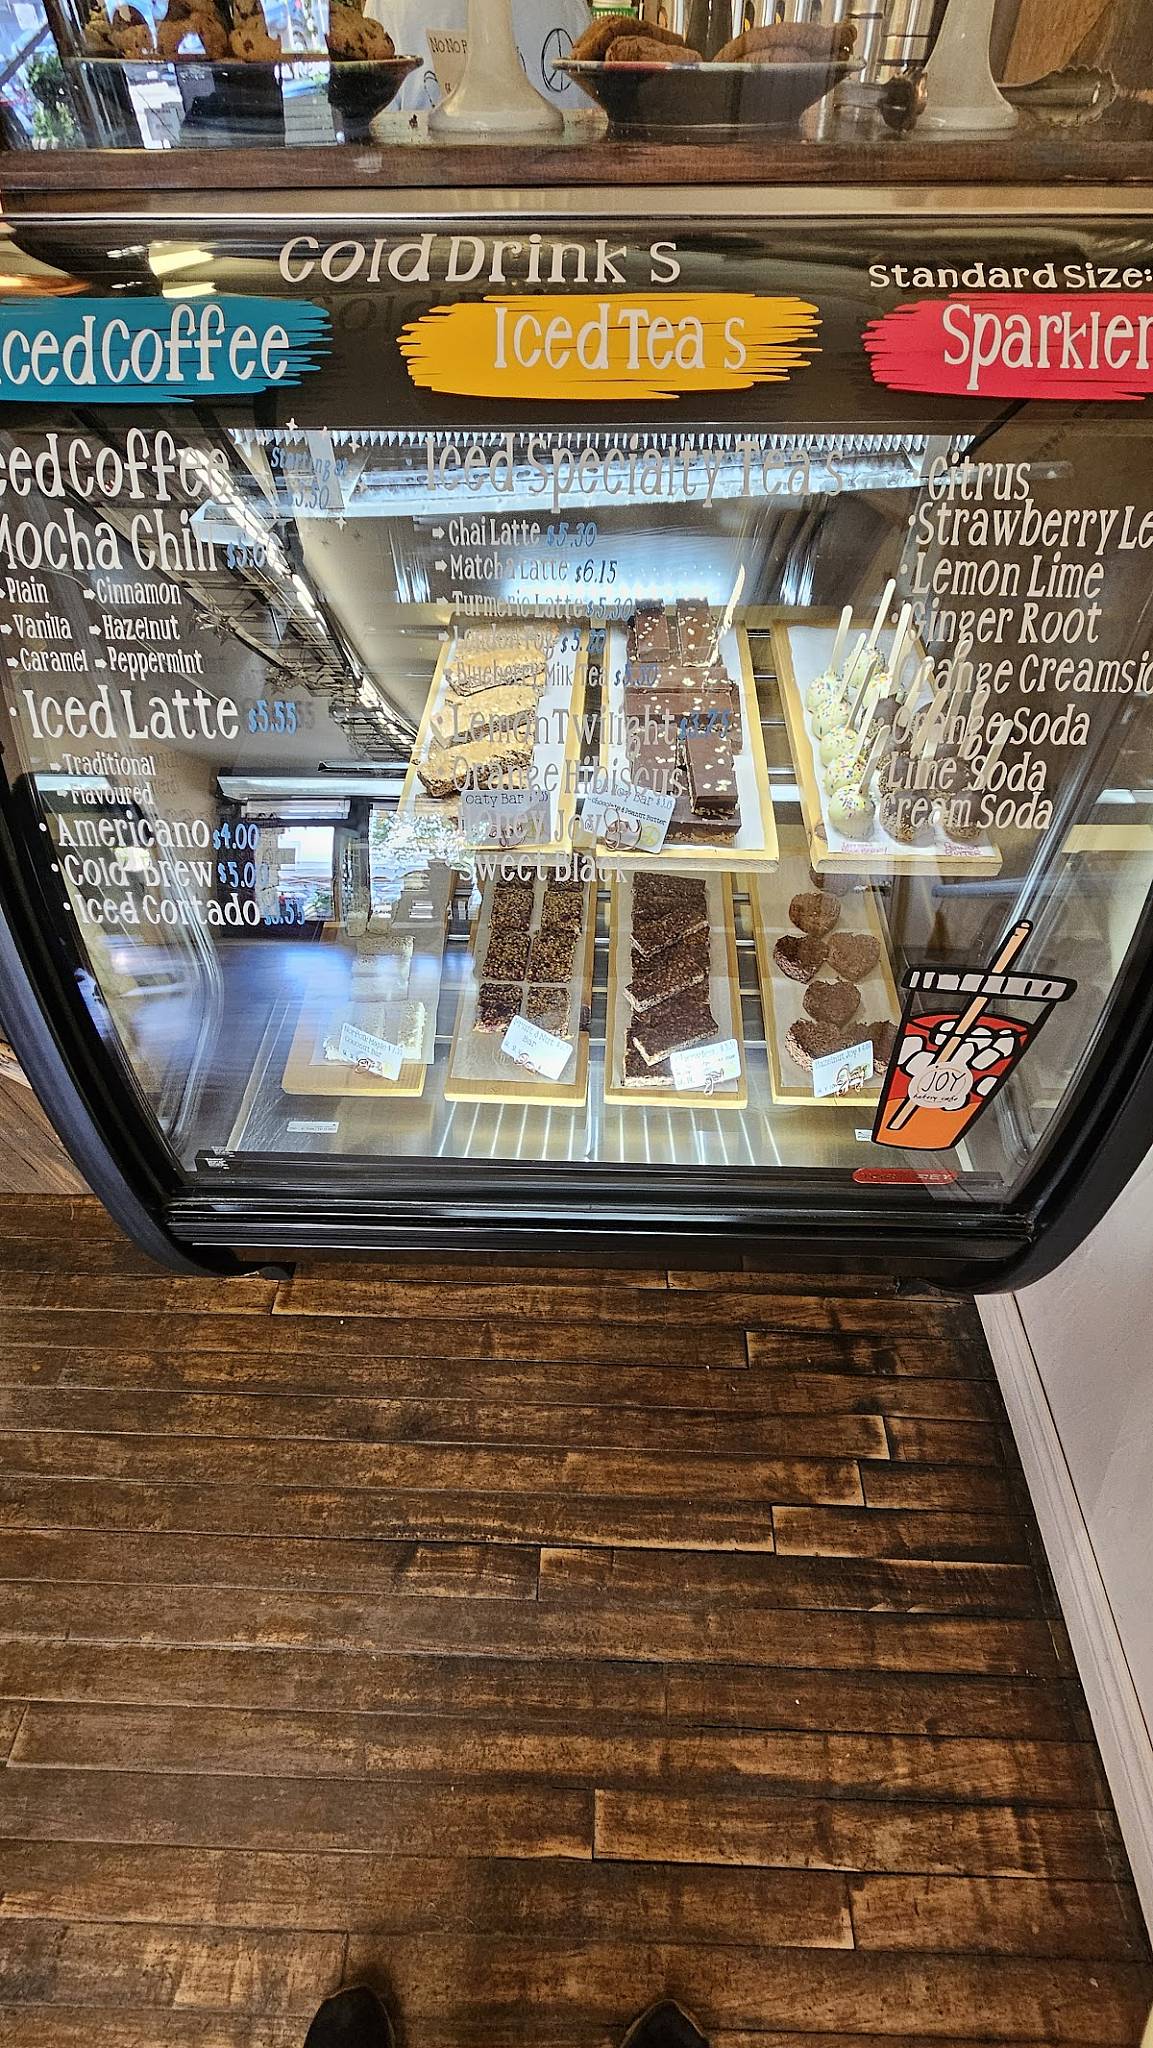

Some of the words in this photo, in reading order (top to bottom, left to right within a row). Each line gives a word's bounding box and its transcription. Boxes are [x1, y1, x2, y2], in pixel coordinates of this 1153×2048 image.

[279, 234, 436, 283] Cold
[869, 262, 1058, 289] Standard
[0, 315, 96, 385] ced
[102, 304, 289, 382] Coffee
[494, 303, 609, 369] Iced
[69, 427, 230, 501] Coffee
[427, 432, 514, 494] Iced
[527, 434, 723, 514] Specialty
[928, 452, 1031, 501] Citrus
[448, 516, 487, 547] Chai
[489, 518, 541, 547] Latte
[916, 498, 1119, 555] Strawberry
[449, 552, 516, 581] Matcha
[519, 557, 569, 582] Latte
[575, 559, 618, 584] $6.15
[911, 551, 1021, 597] Lemon
[1027, 551, 1104, 598] Lime
[5, 576, 49, 603] Plain
[96, 576, 182, 605] Cinnamon
[452, 589, 529, 618] Turmeric
[534, 592, 585, 620] Latte
[12, 612, 73, 639] Vanilla
[102, 613, 180, 641] Hazelnut
[908, 597, 1014, 660] Ginger
[1018, 602, 1102, 643] Root
[20, 647, 89, 672] Caramel
[107, 645, 204, 681] Peppermint
[546, 661, 574, 687] Milk
[23, 685, 117, 740] Iced
[120, 688, 239, 740] Latte
[1010, 703, 1091, 746] Soda
[62, 751, 156, 777] Traditional
[961, 752, 1047, 792] Soda
[71, 783, 155, 806] Flavoured
[977, 792, 1054, 829] Soda
[57, 810, 210, 849] Americano
[213, 823, 259, 850] $4.00
[64, 853, 130, 887] Cold
[75, 892, 138, 925] Iced
